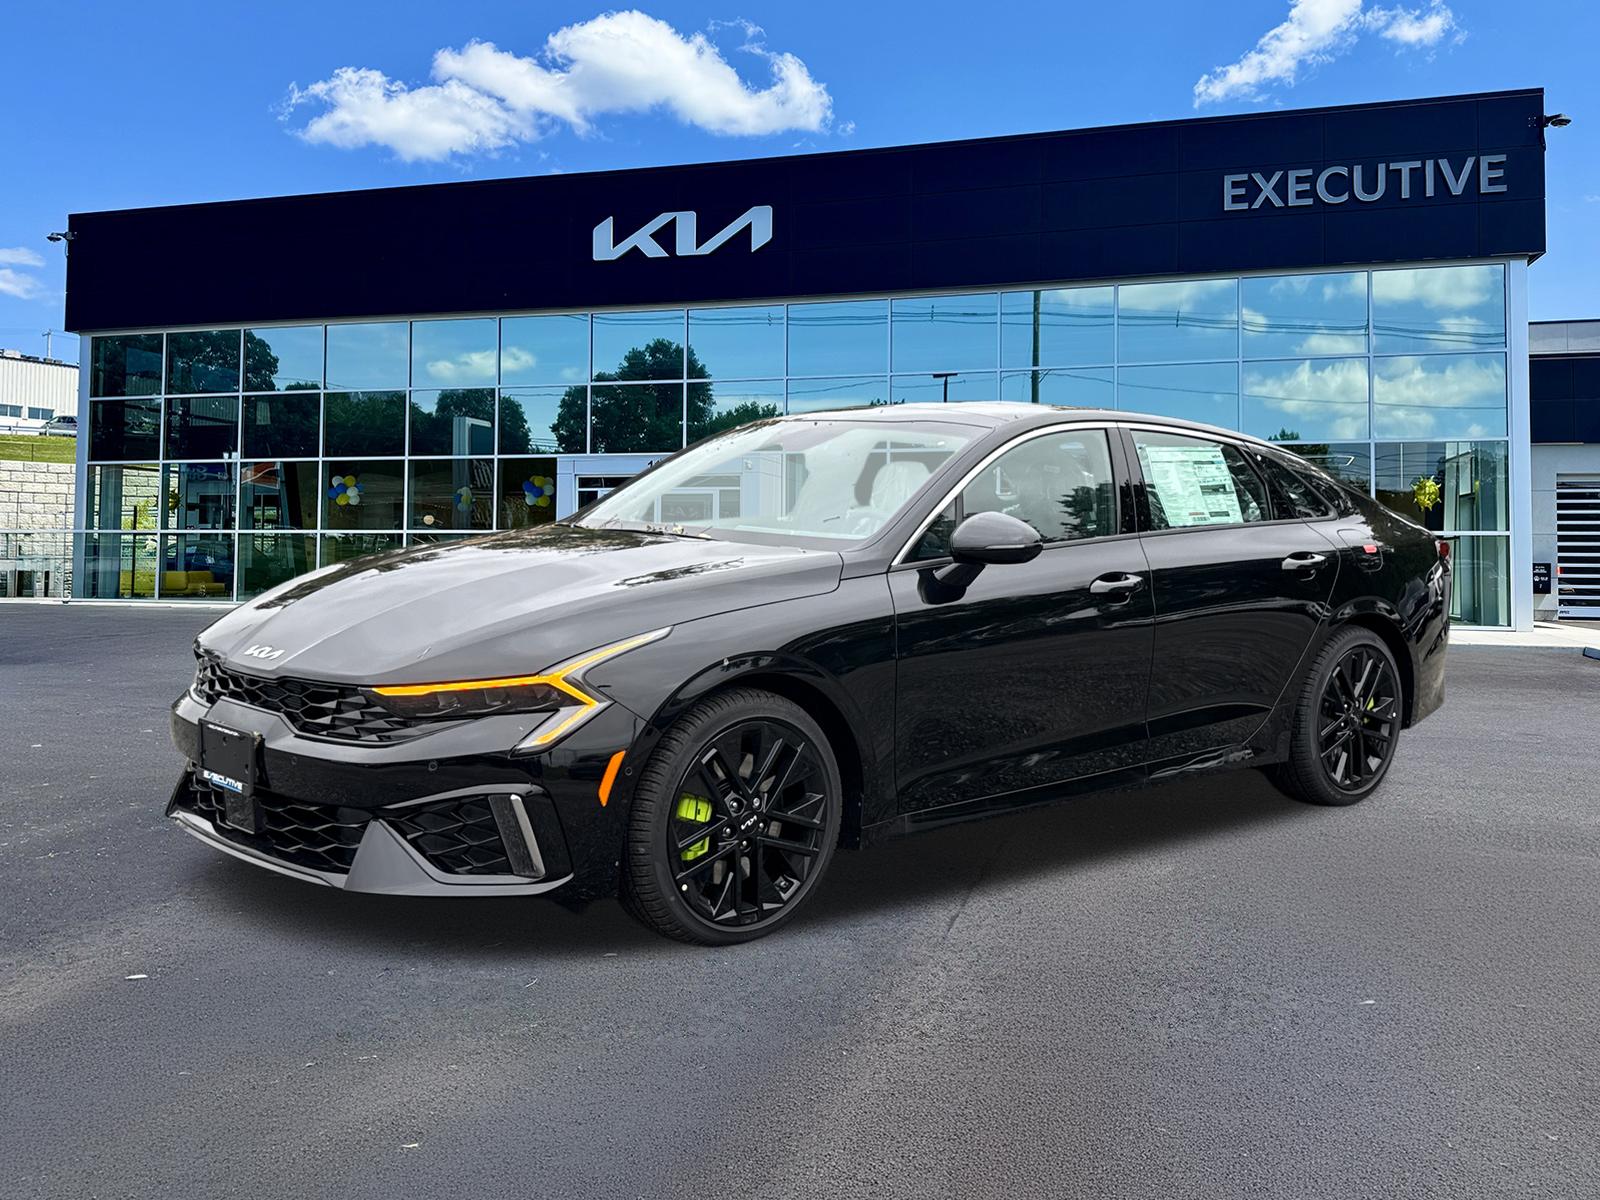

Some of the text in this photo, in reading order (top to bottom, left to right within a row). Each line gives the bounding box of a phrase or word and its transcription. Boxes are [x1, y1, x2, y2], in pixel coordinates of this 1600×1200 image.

[1223, 154, 1508, 211] EXECUTIVE
[593, 205, 773, 261] KIA
[244, 644, 285, 660] KIA
